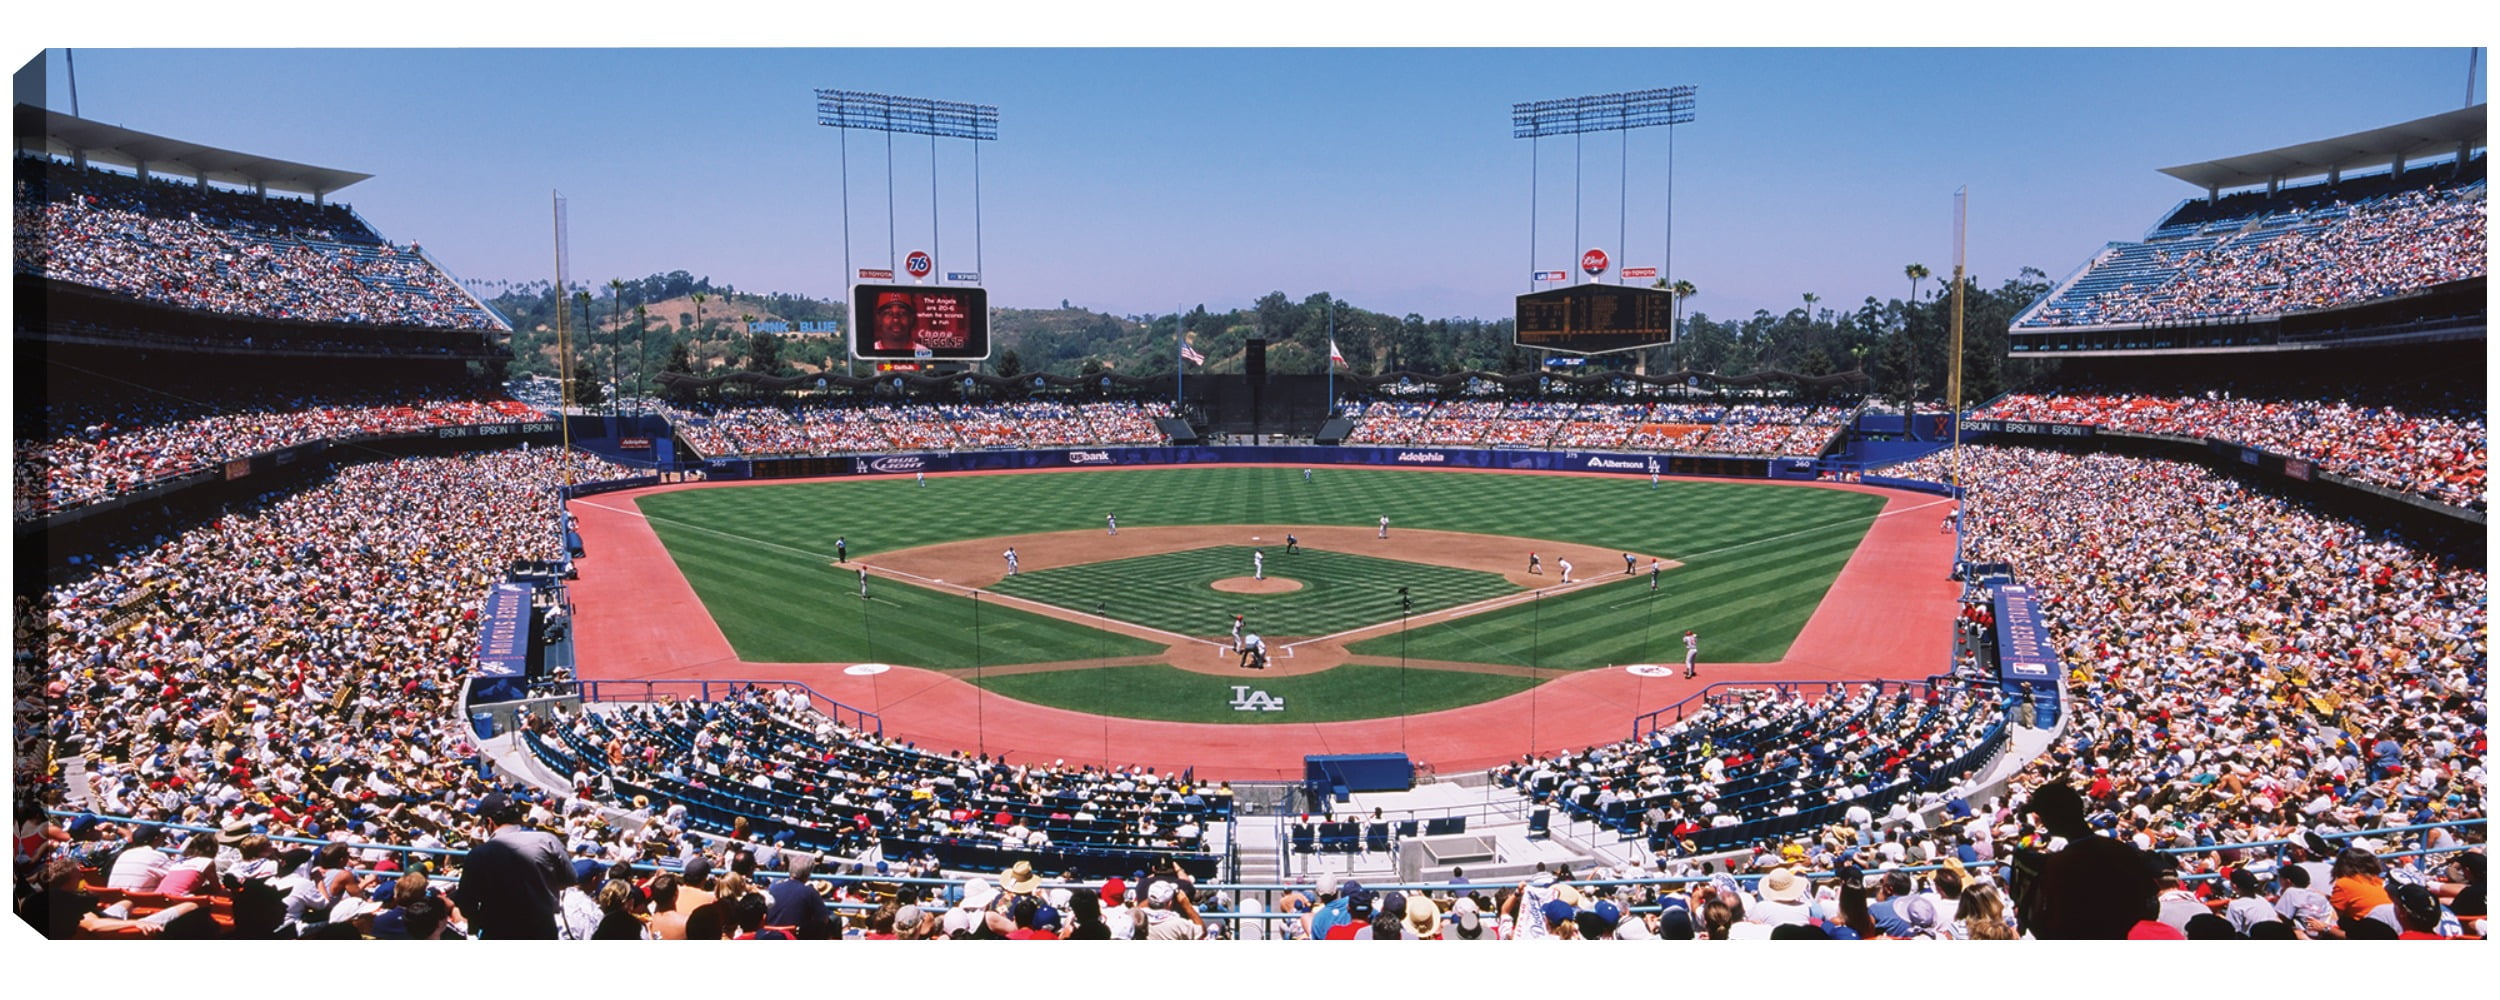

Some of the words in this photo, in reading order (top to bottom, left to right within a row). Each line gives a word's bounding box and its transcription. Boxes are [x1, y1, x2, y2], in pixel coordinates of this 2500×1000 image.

[909, 257, 927, 271] 76
[1583, 256, 1605, 266] Bud
[868, 270, 892, 278] TOYOTA
[800, 321, 837, 332] BLUE
[439, 428, 466, 438] EPSON
[480, 425, 508, 435] EPSON
[522, 423, 553, 433] EPSON
[1960, 421, 1990, 431] EPSON
[2006, 423, 2037, 434] EPSON
[2052, 425, 2080, 436] EPSON
[1398, 452, 1444, 463] Adelphia
[856, 457, 868, 473] LA
[1603, 459, 1644, 469] Albertsons
[1648, 456, 1661, 473] LA
[1794, 460, 1810, 468] 360
[1229, 686, 1284, 711] LA
